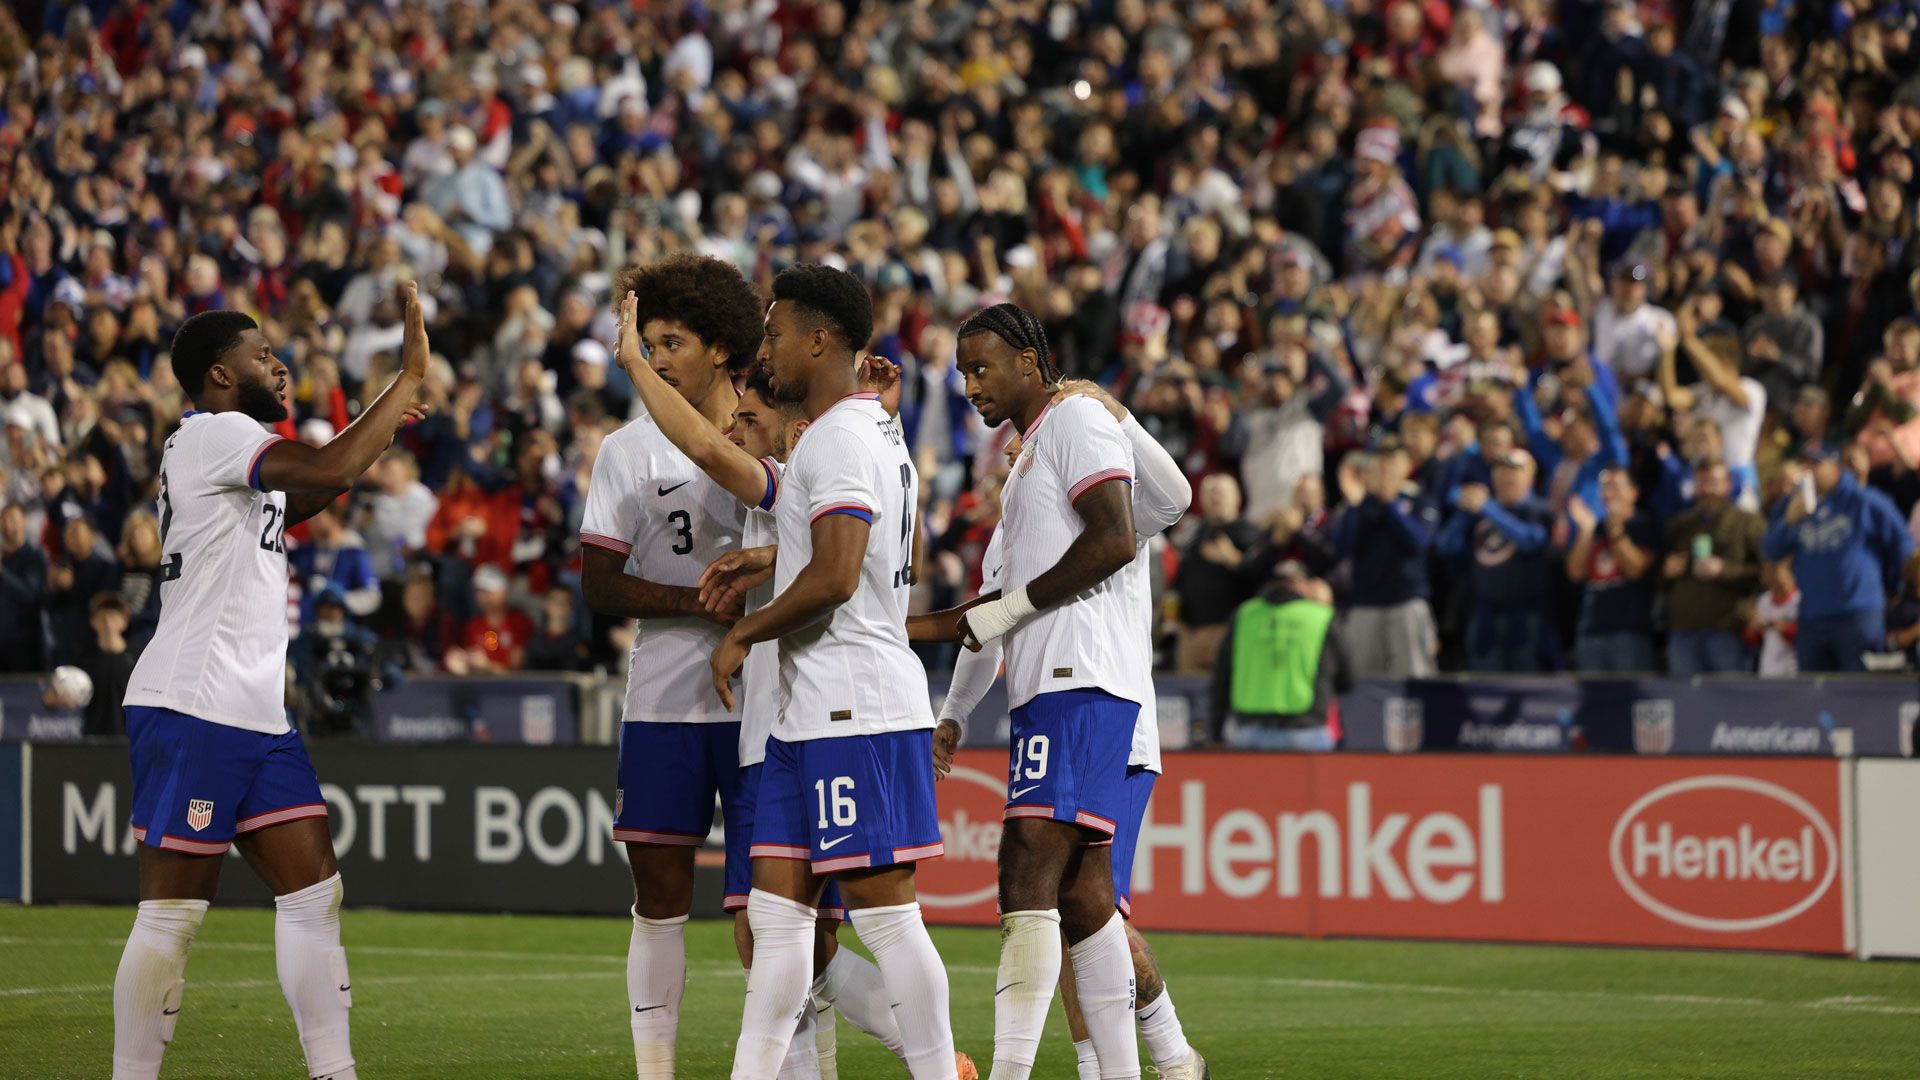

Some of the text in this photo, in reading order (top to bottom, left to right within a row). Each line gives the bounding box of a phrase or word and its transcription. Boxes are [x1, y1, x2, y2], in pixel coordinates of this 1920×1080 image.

[667, 509, 693, 555] 3
[1014, 735, 1050, 782] 19
[1711, 722, 1821, 751] American
[191, 800, 212, 814] USA
[815, 776, 857, 829] 16
[1133, 779, 1504, 904] Henkel
[1632, 821, 1815, 882] Henkel
